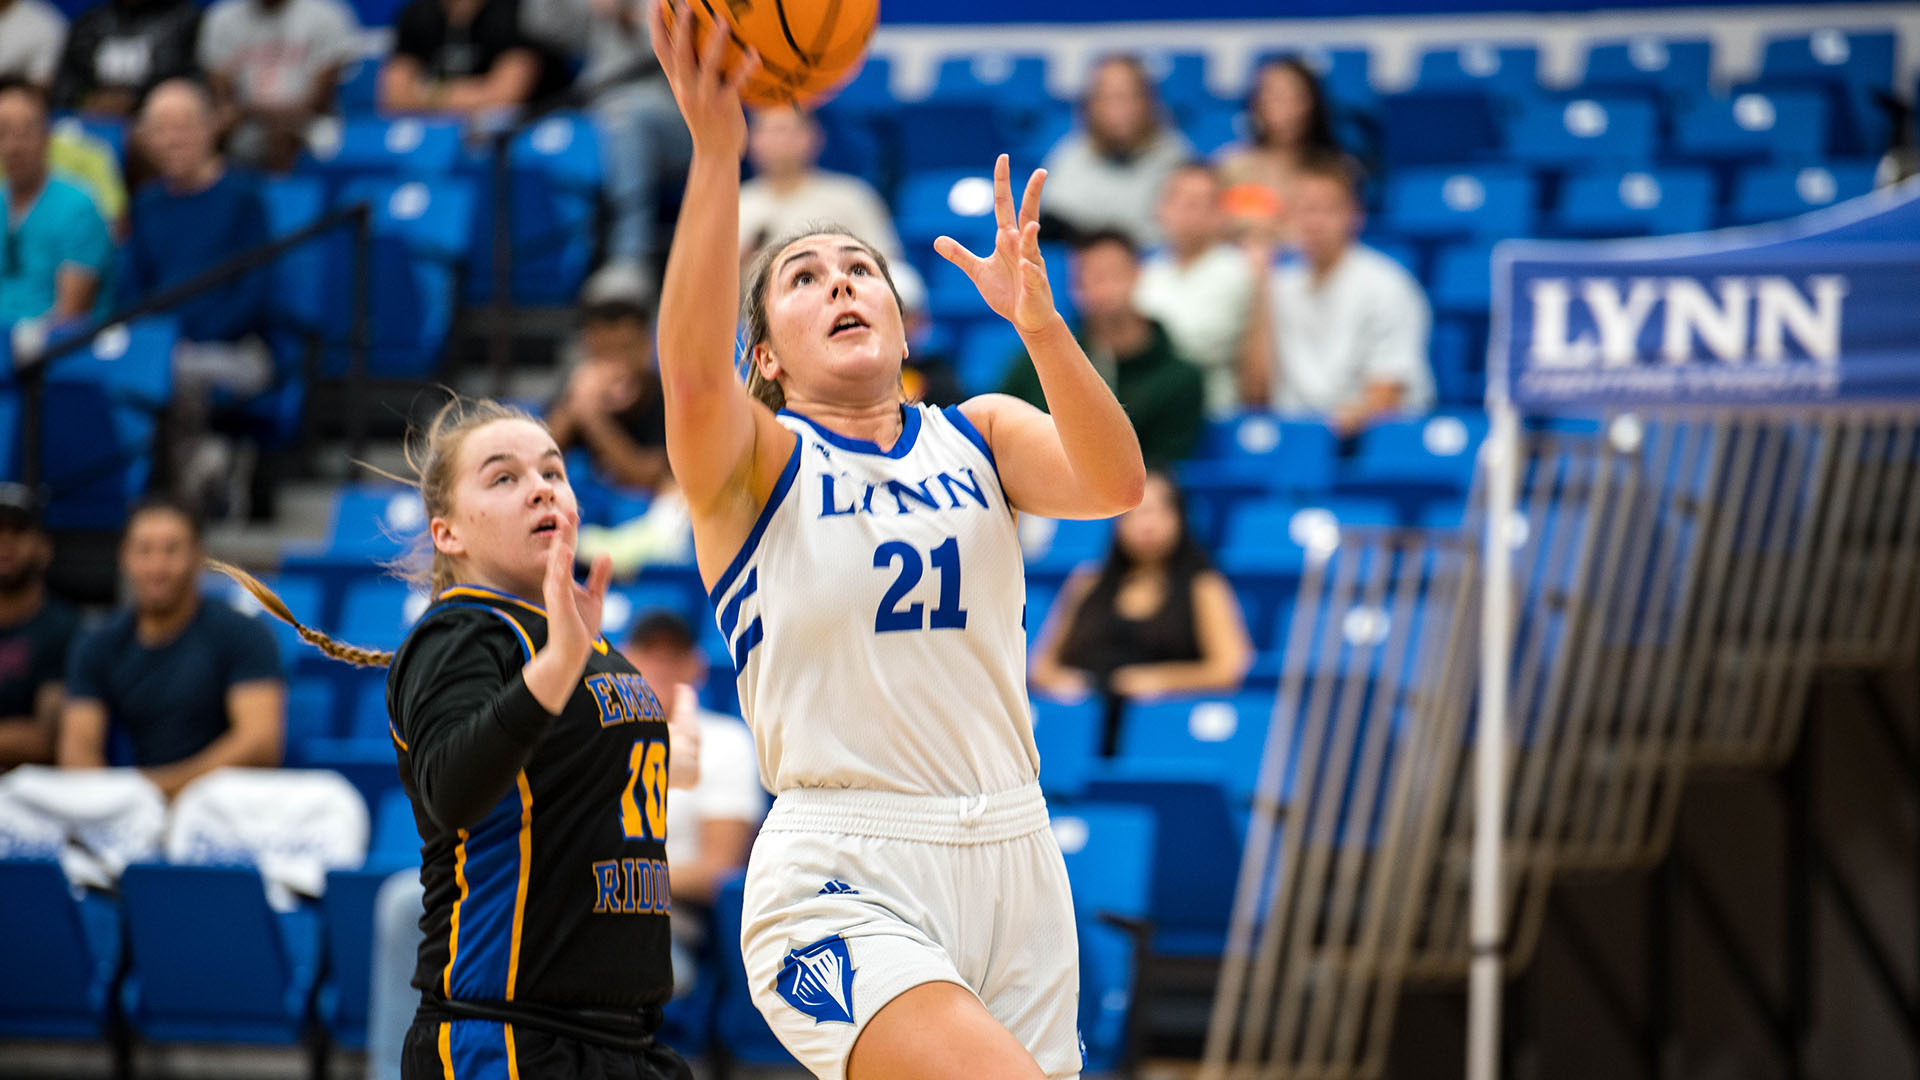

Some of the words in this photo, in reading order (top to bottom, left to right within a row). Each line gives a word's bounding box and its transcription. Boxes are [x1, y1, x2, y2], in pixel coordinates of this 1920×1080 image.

[1530, 275, 1848, 368] LYNN
[817, 467, 989, 519] LYNN
[873, 536, 968, 634] 21
[618, 737, 669, 843] 10
